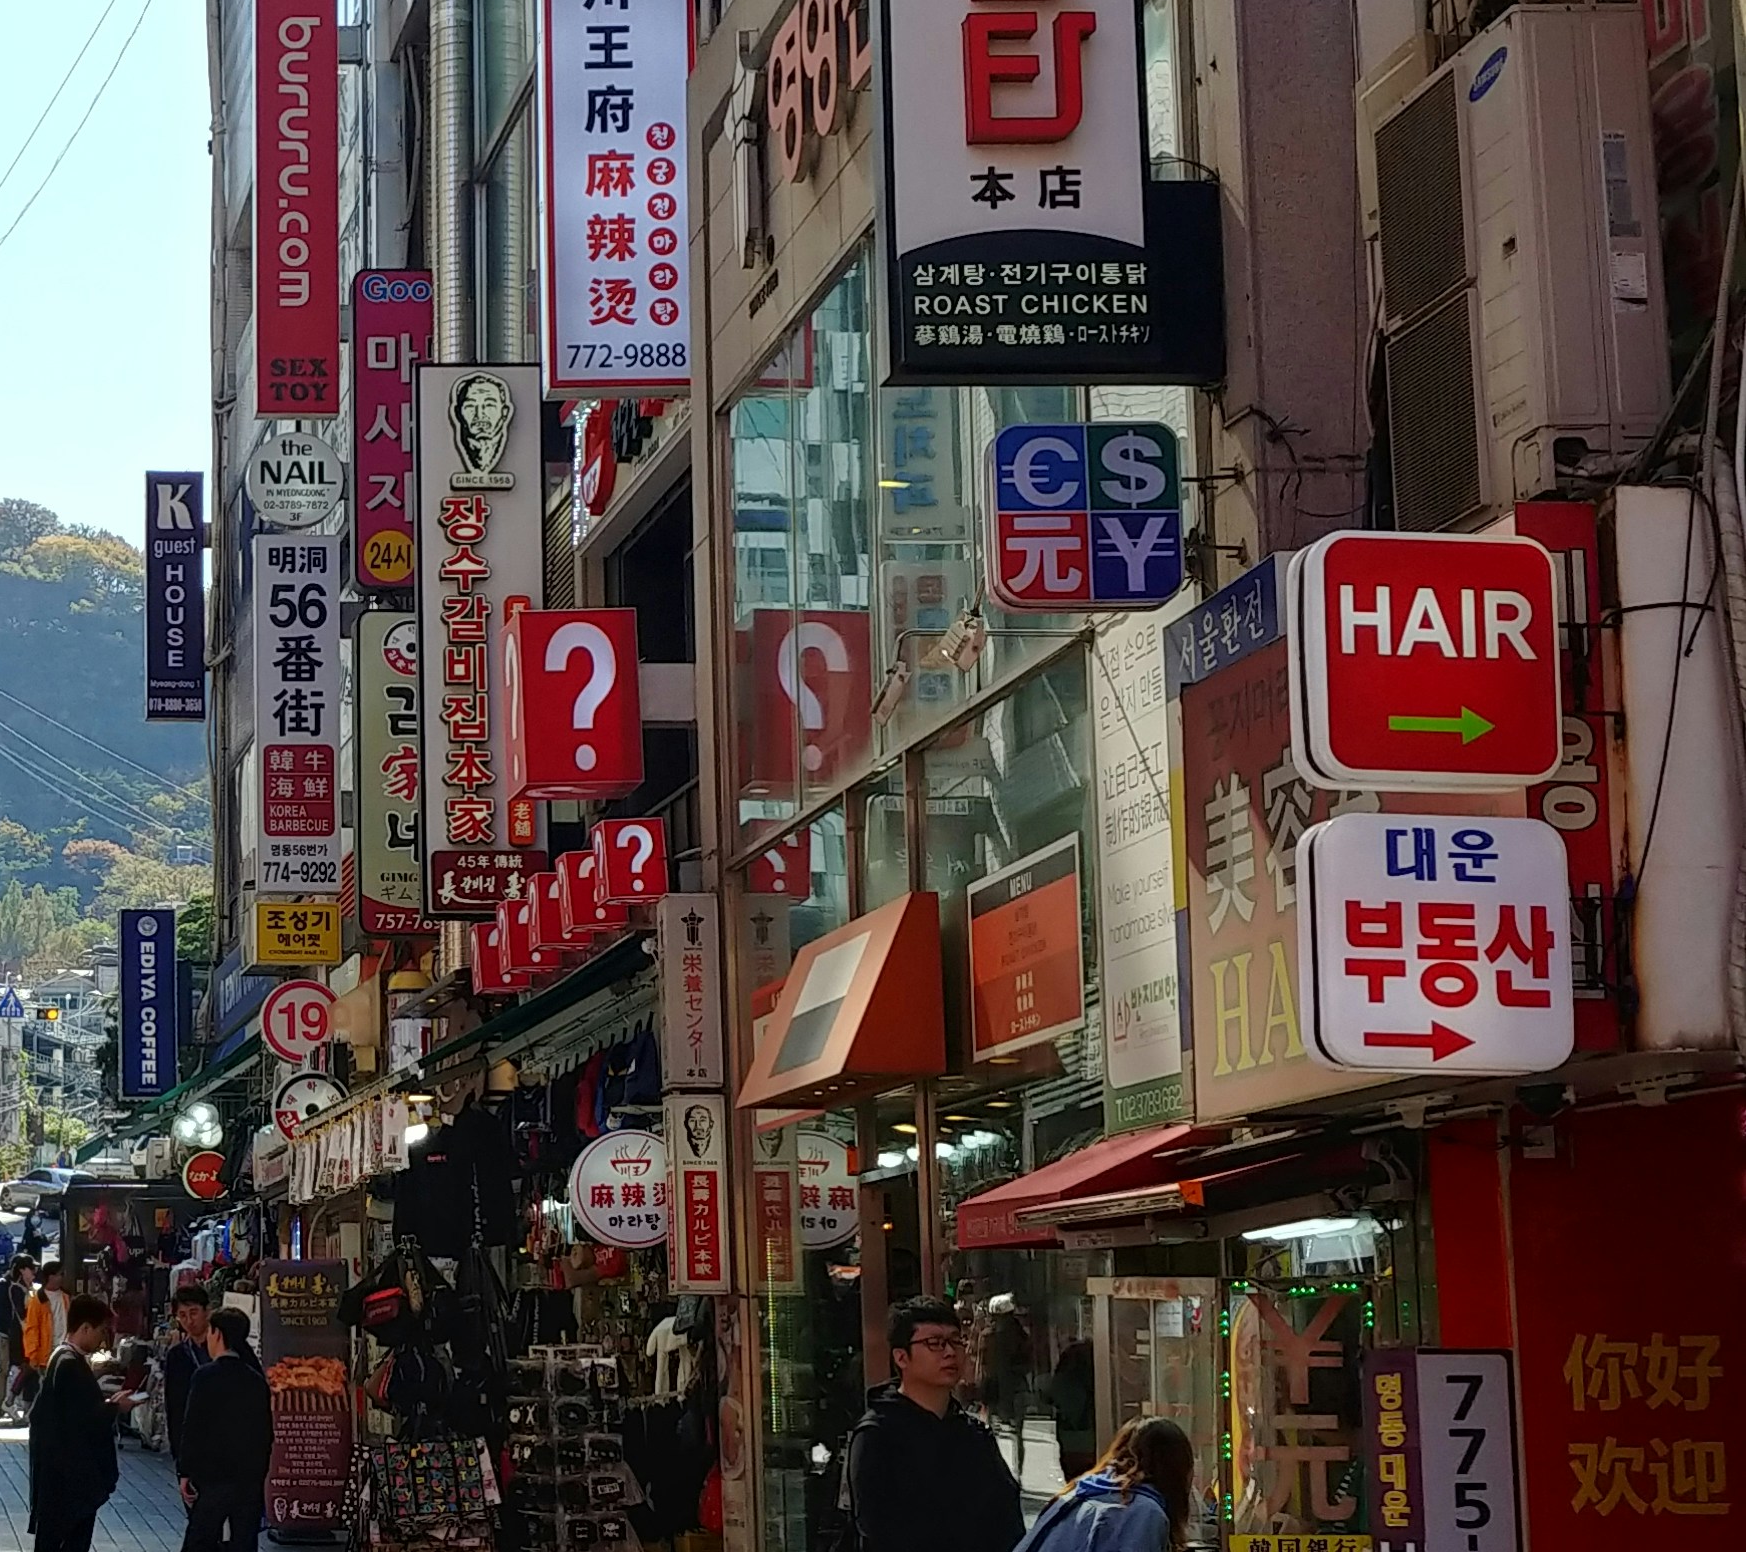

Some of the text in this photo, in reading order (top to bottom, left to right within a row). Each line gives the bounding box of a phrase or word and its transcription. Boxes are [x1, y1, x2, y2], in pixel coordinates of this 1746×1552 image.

[278, 17, 320, 307] bururu.com
[970, 166, 1082, 210] 本店
[585, 150, 637, 326] 麻辣烫
[914, 294, 1148, 315] ROAST CHICKEN
[270, 357, 327, 377] SEX
[567, 344, 686, 368] 772-9888
[270, 382, 328, 401] TOY
[281, 439, 313, 457] the
[259, 461, 337, 486] NAIL
[156, 483, 194, 530] K
[263, 500, 329, 511] 02-3789-7872
[289, 511, 303, 522] 3F
[154, 537, 196, 558] guest
[268, 546, 327, 574] 明洞
[165, 564, 185, 668] HOUSE
[269, 583, 328, 628] 56
[1339, 585, 1537, 661] HAIR
[269, 806, 307, 819] KOREA
[270, 819, 329, 832] BARBECUE
[1385, 826, 1500, 886] 대운
[263, 861, 337, 885] 774-9292
[1009, 871, 1034, 898] MENU
[267, 910, 331, 931] 조성기
[1344, 900, 1555, 1009] 부동산
[140, 942, 157, 1085] EDIYA COFFEE
[278, 1001, 328, 1042] 19
[1565, 1333, 1724, 1412] 你好
[1567, 1437, 1732, 1517] 欢迎
